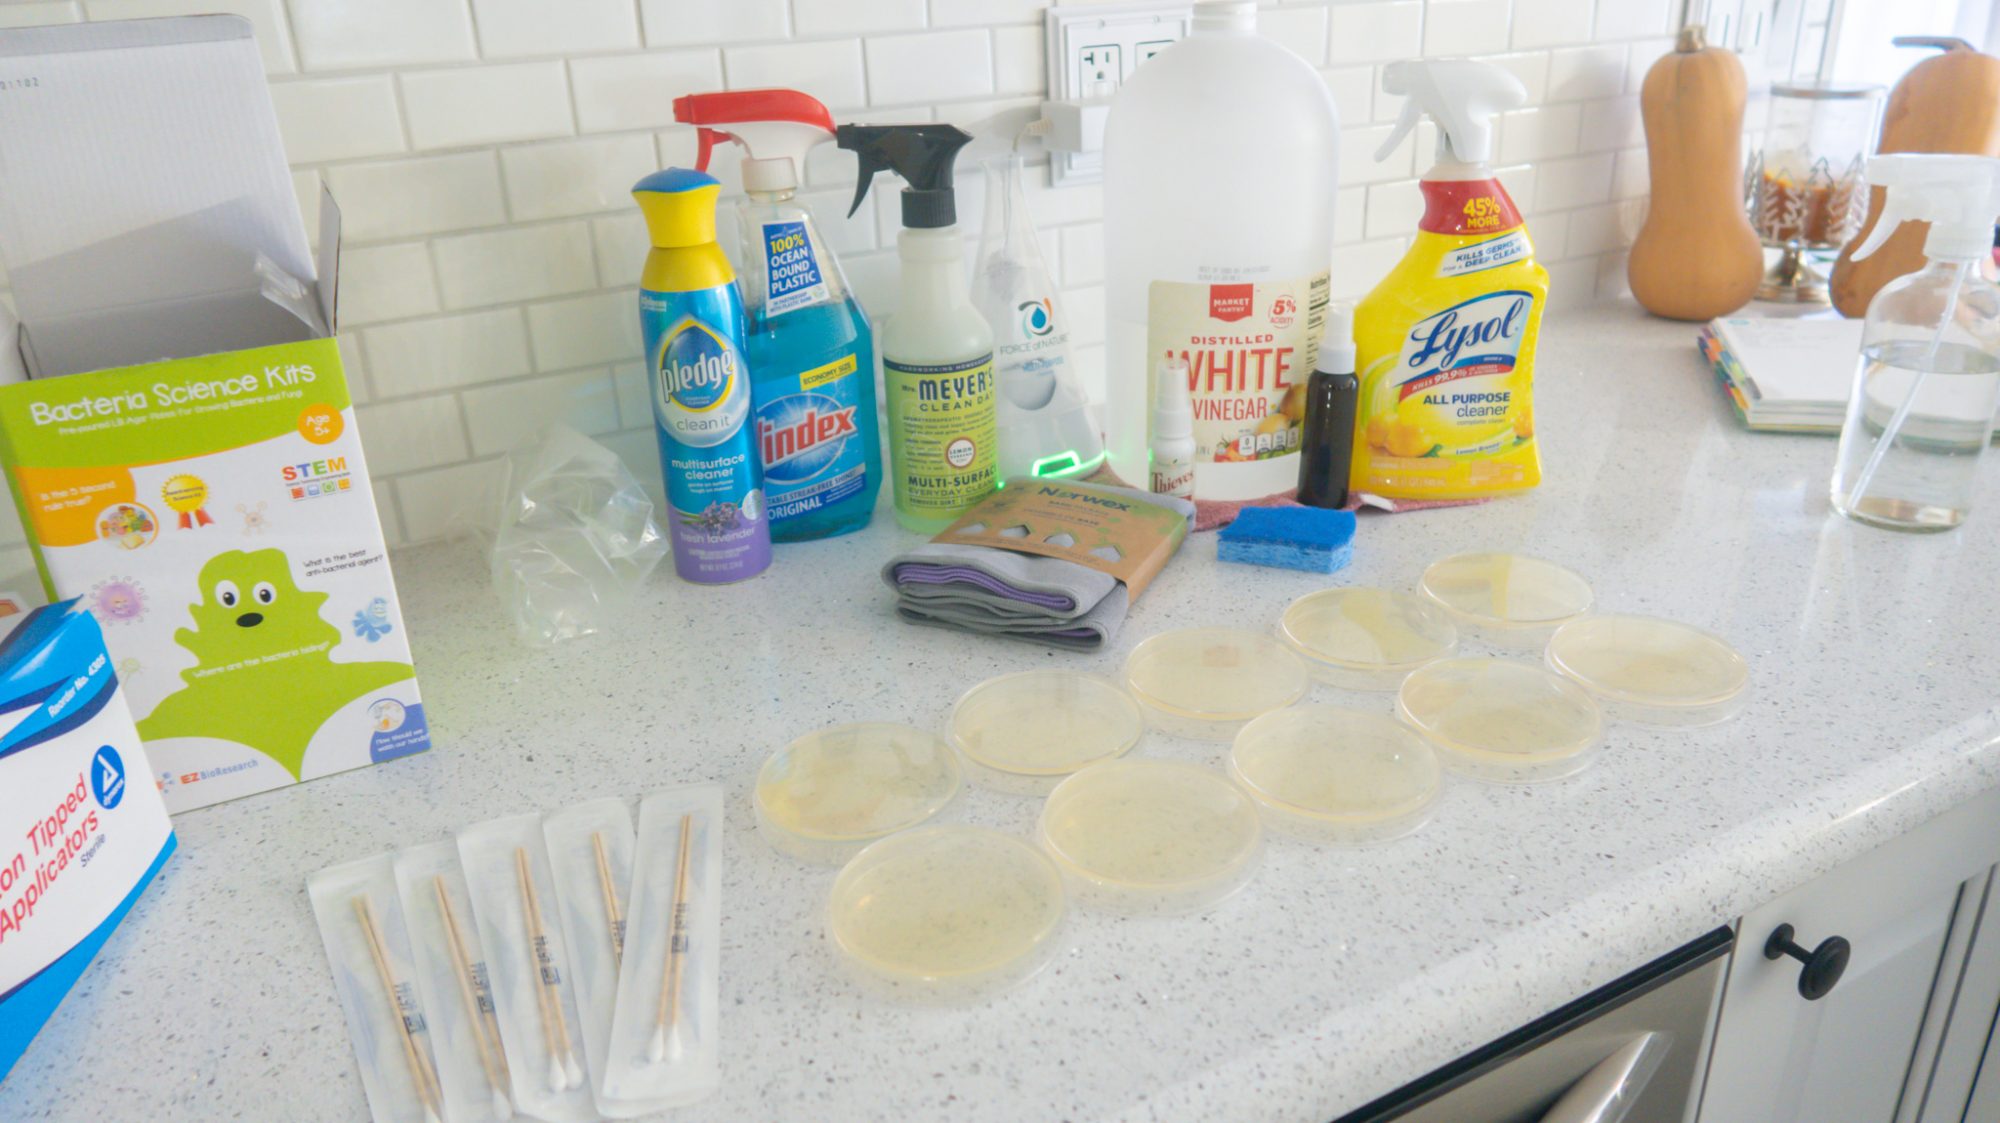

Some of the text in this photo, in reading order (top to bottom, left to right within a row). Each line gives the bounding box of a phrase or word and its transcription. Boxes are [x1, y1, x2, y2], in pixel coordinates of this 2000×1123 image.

[1463, 196, 1501, 217] 45%
[1467, 215, 1500, 228] MORE
[770, 232, 805, 254] 100%
[770, 246, 808, 268] OCEAN
[1456, 250, 1484, 262] KILLS
[1464, 256, 1491, 268] DEEP
[1492, 246, 1521, 261] CLEAN
[771, 260, 810, 281] BOUND
[771, 270, 816, 294] PLASTIC
[1213, 297, 1250, 307] MARKET
[1272, 298, 1297, 315] 5%
[1190, 333, 1274, 345] DISTILLED
[1408, 297, 1525, 369] Lysol
[1000, 341, 1032, 355] FORCE
[660, 349, 734, 405] pledge
[802, 361, 852, 386] ECONOMY SIZE
[1166, 347, 1294, 392] WHITE
[1433, 367, 1468, 385] 99.9%
[30, 363, 317, 426] Bacteria Science Kits
[1423, 391, 1511, 405] ALL PURPOSE
[919, 400, 972, 412] CLEAN
[1192, 396, 1268, 421] VINEGAR
[1456, 404, 1510, 418] cleaner
[306, 414, 330, 428] Age
[314, 426, 330, 437] 5+
[676, 415, 730, 431] clean it
[282, 456, 347, 481] STEM
[671, 453, 745, 470] multisurface
[685, 467, 734, 480] cleaner
[908, 464, 997, 488] MULTI-SURFAC
[1151, 470, 1193, 494] Thieves
[767, 495, 823, 520] ORIGINAL
[1038, 486, 1130, 512] Norwex
[707, 526, 755, 544] lavender
[348, 549, 366, 559] best
[306, 561, 356, 577] anti-bacterial
[0, 771, 88, 899] on Tipped
[80, 833, 106, 868] Sterile
[0, 809, 99, 944] Applicators
